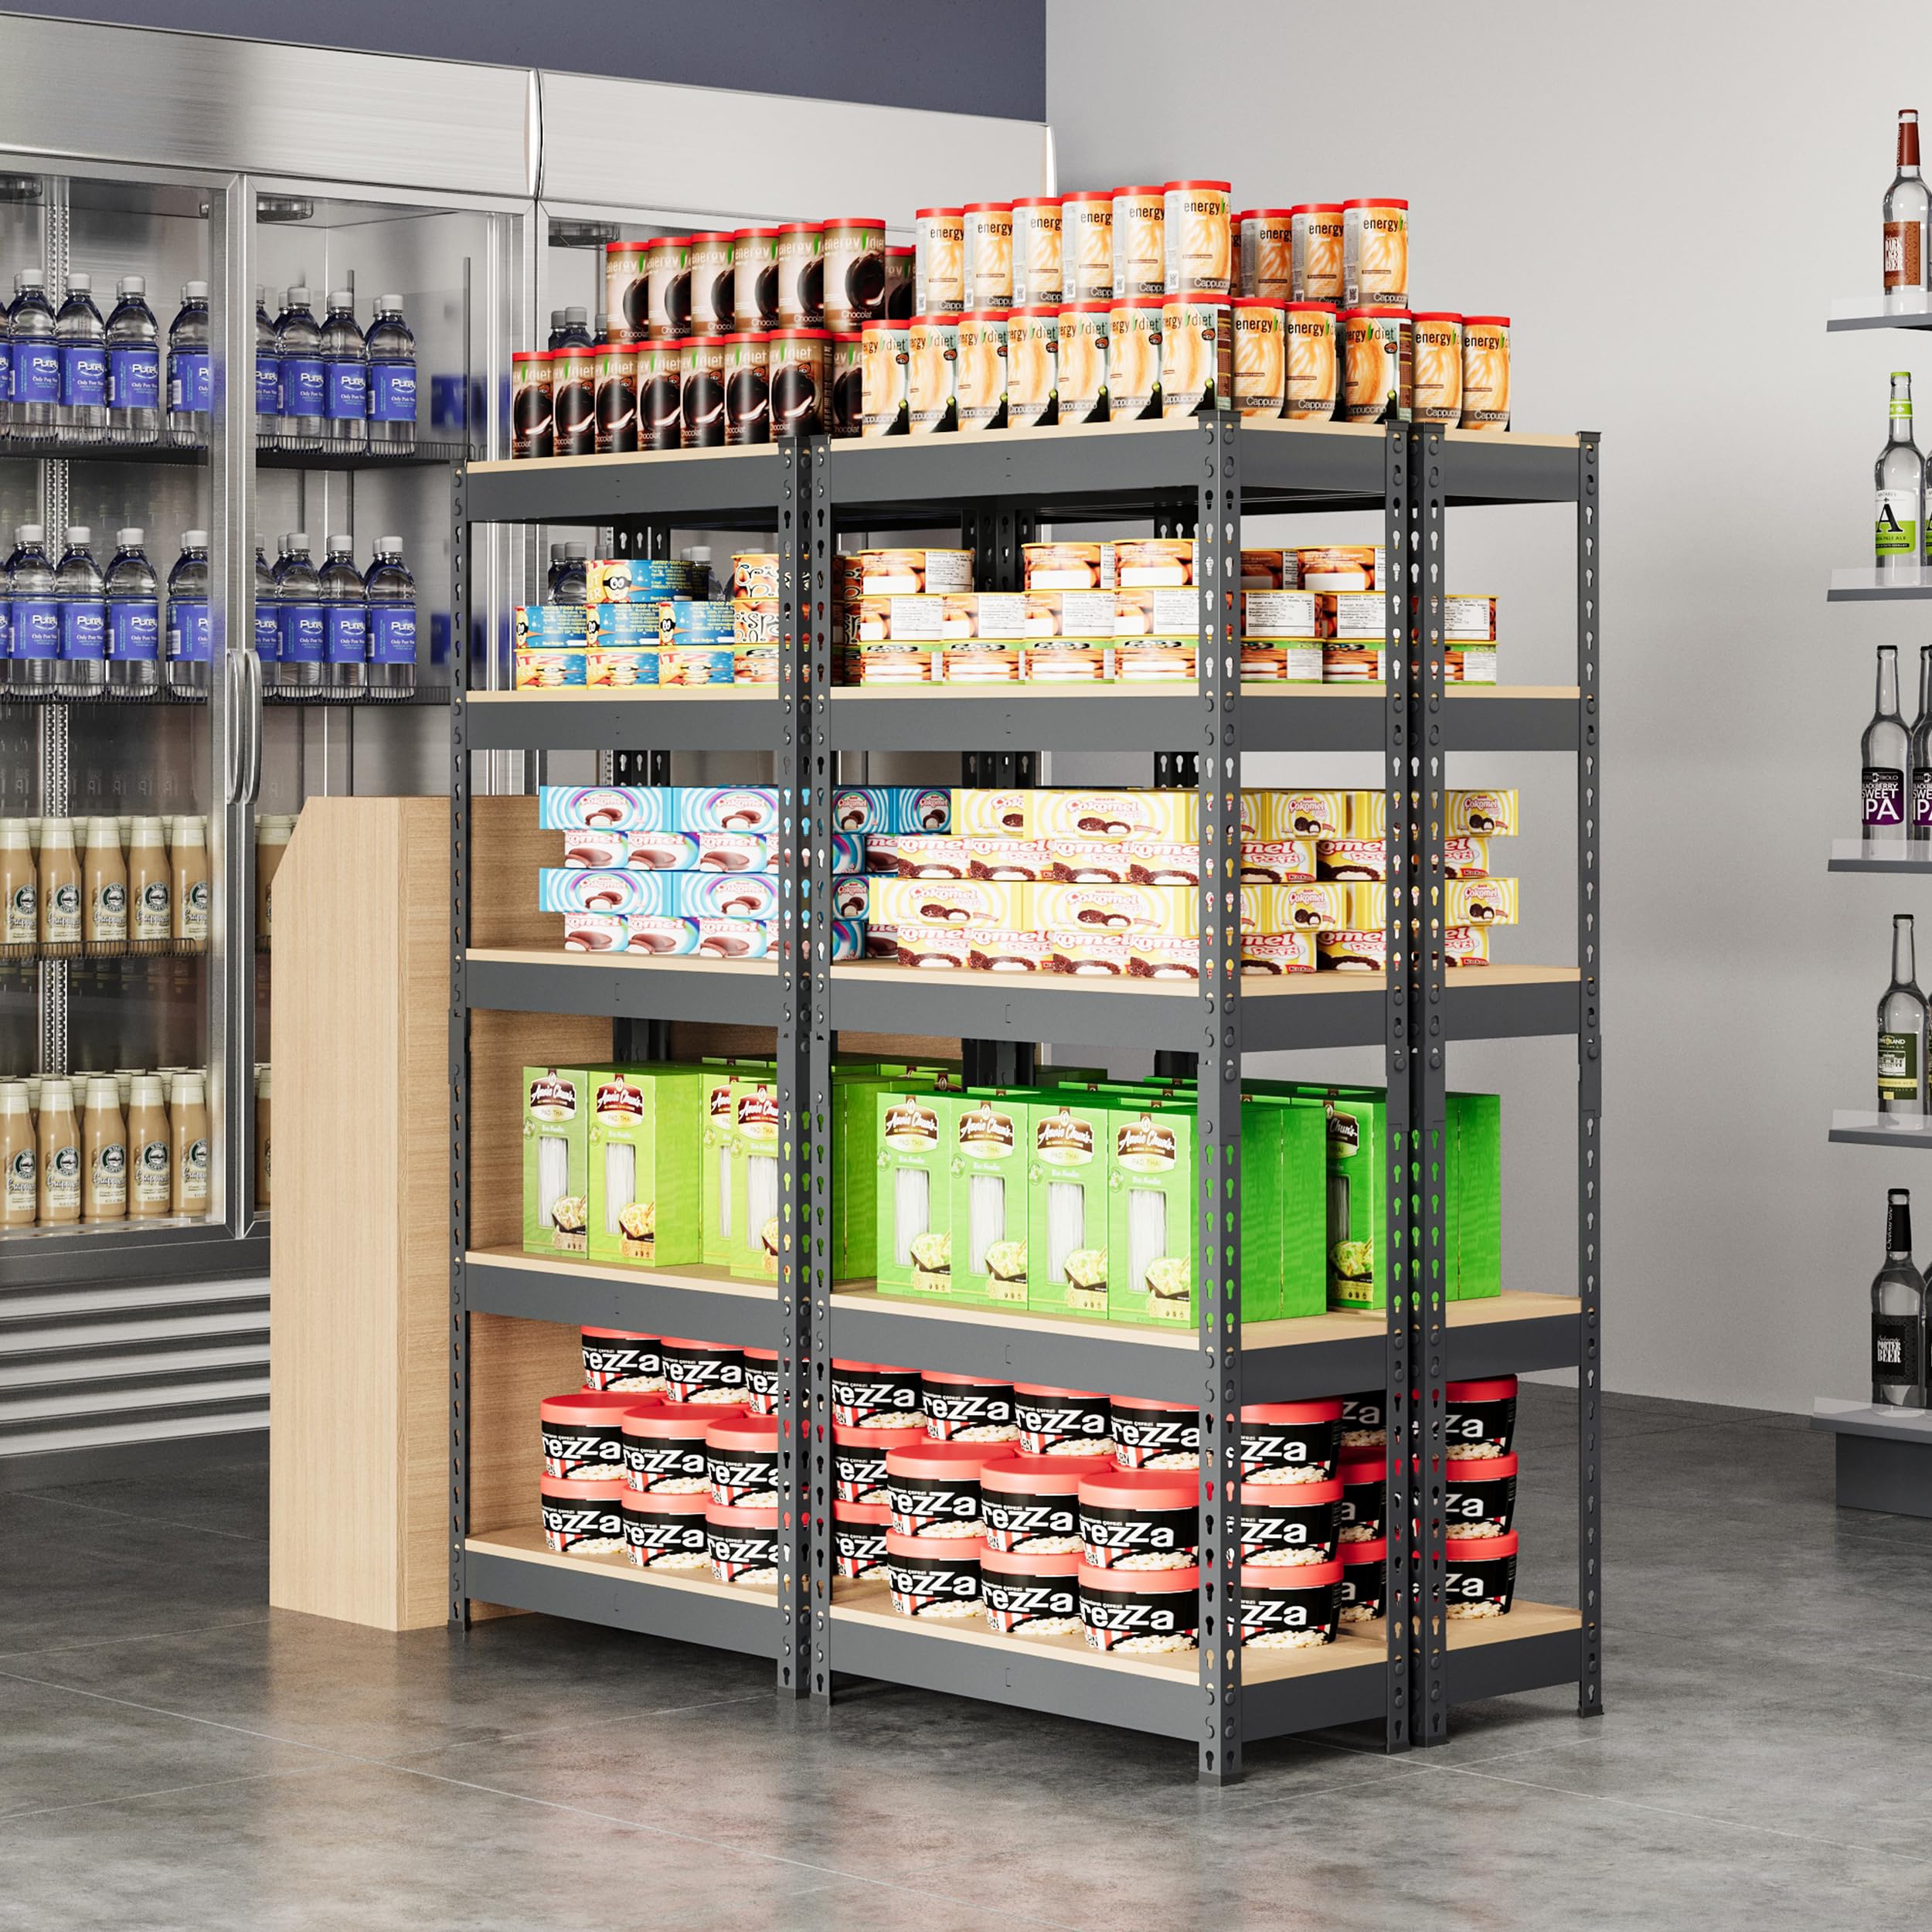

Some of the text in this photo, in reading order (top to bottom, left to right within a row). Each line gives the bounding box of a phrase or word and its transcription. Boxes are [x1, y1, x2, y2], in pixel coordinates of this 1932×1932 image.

[1031, 218, 1063, 230] energ
[1111, 317, 1160, 333] ergy diet
[1163, 314, 1212, 329] ergy diet
[1008, 325, 1056, 342] ergy diet
[1059, 321, 1105, 338] ergy diet
[1347, 327, 1394, 342] ergy diet
[910, 335, 954, 349] ergy diet
[959, 332, 1008, 345] ergy diet
[862, 341, 906, 353] ergy diet
[1876, 503, 1903, 532] A
[1862, 788, 1899, 799] SWEET
[1913, 789, 1932, 799] SWE
[1913, 799, 1932, 821] IP
